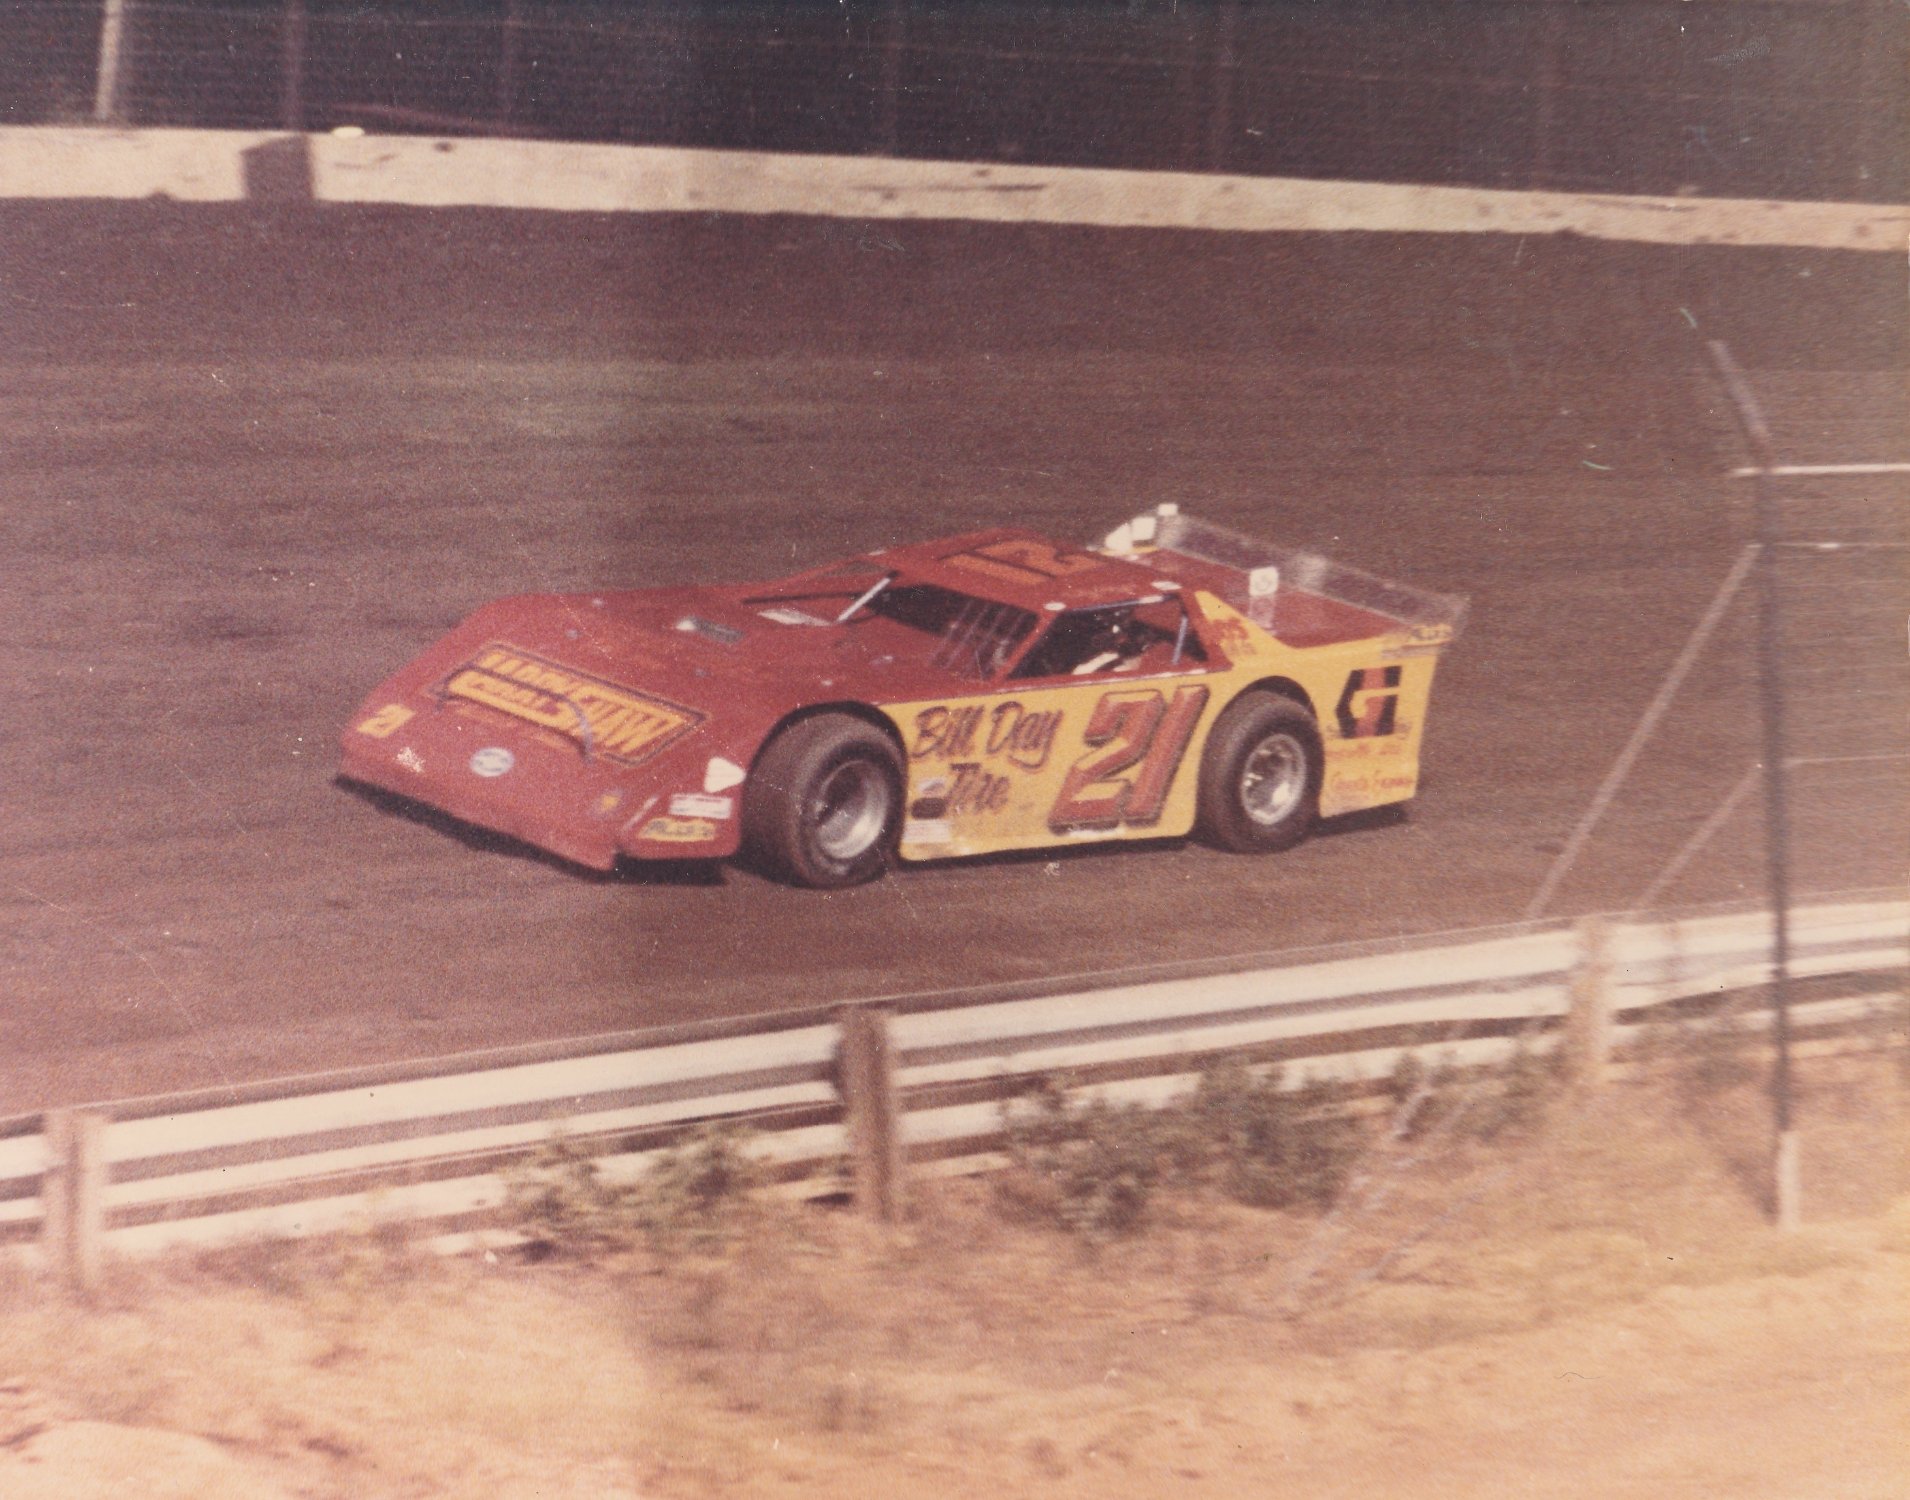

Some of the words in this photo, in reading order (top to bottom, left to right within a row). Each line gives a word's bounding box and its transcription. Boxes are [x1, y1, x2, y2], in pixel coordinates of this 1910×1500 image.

[911, 706, 984, 759] Bill
[985, 701, 1065, 774] Day
[1049, 684, 1211, 836] 21
